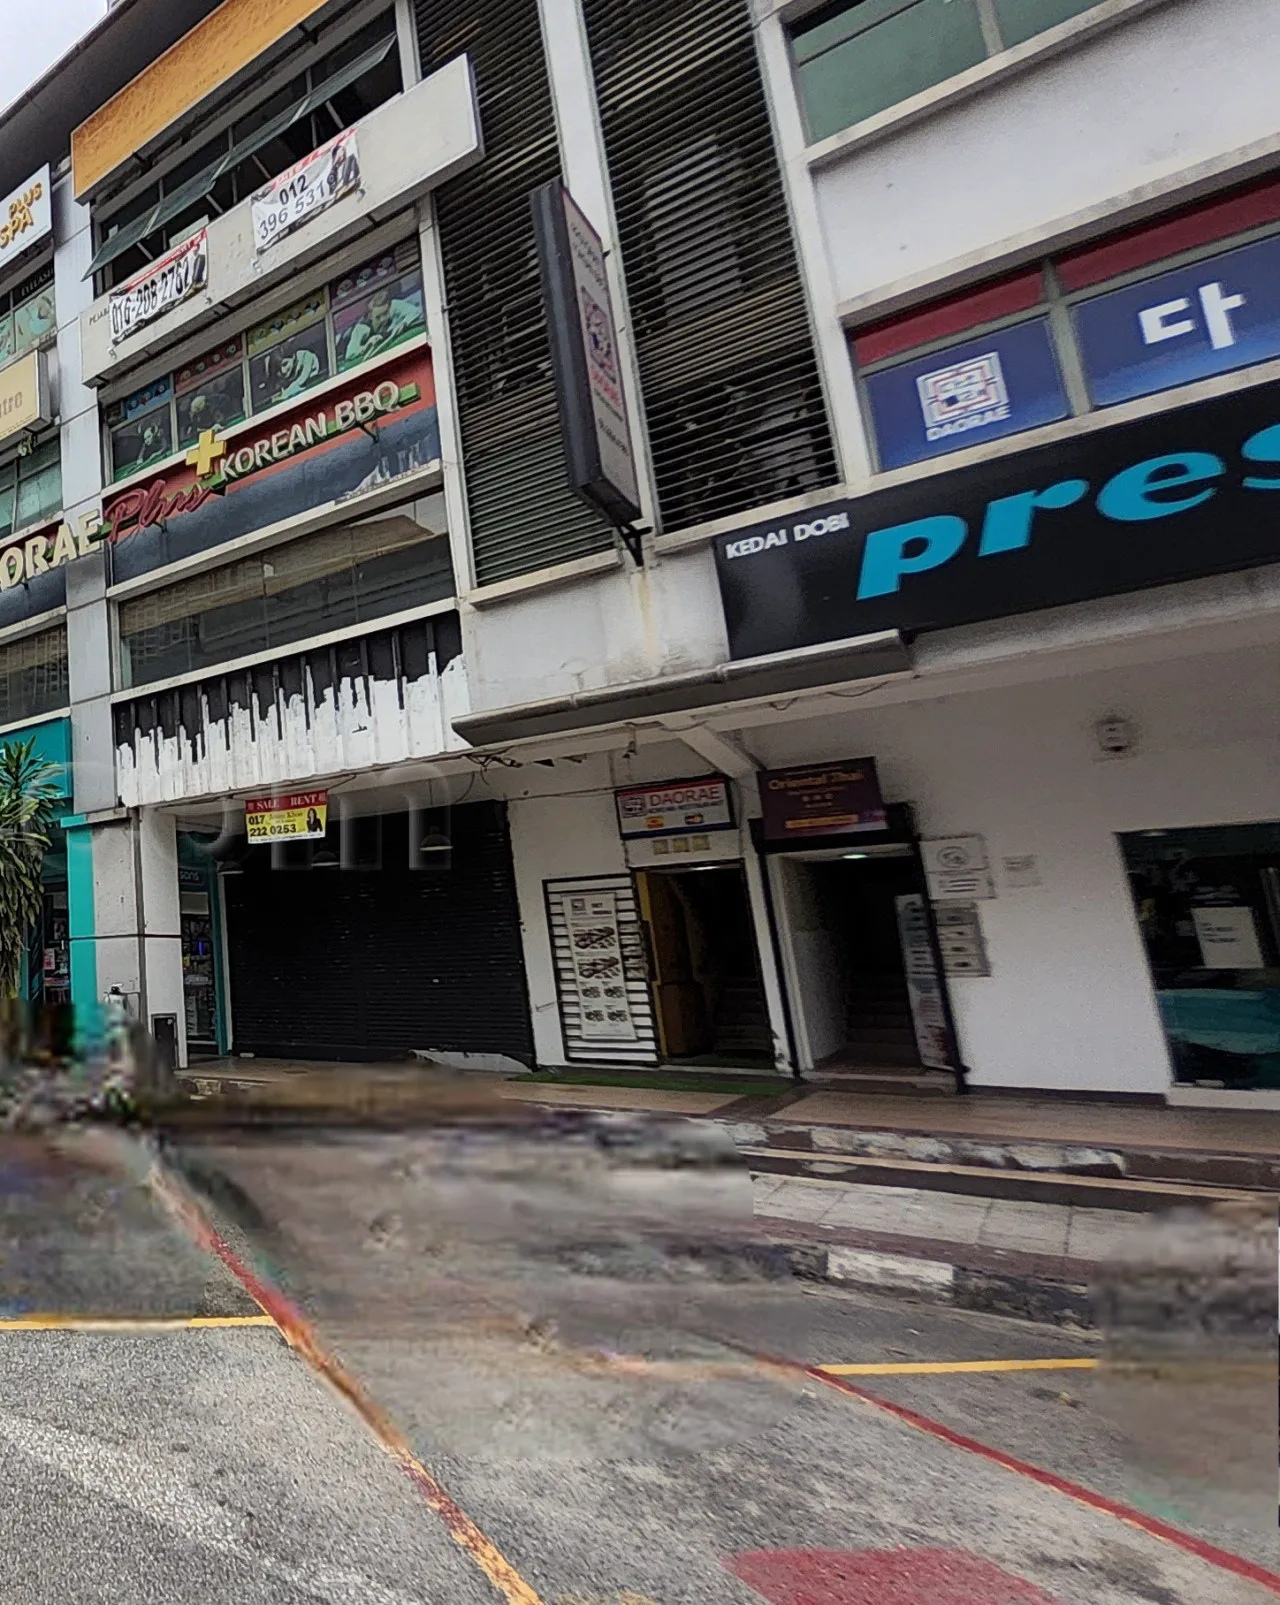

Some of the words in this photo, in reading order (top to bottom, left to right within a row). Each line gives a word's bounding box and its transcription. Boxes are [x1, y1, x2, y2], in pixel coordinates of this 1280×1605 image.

[9, 182, 42, 218] PLUS
[280, 175, 308, 205] 012
[0, 207, 34, 249] SPA
[260, 208, 288, 240] 396
[1137, 282, 1245, 351] 다
[926, 405, 1012, 441] DAORAE
[104, 479, 215, 544] Plus
[219, 412, 328, 481] KOREAN
[335, 381, 400, 431] BBQ
[726, 529, 789, 560] KEDAI
[794, 512, 851, 544] DOBI
[257, 799, 279, 810] SALE
[290, 794, 317, 806] RENT
[649, 786, 720, 806] DAORAE
[248, 814, 266, 825] 017
[249, 826, 268, 837] 222
[270, 823, 297, 835] 0253
